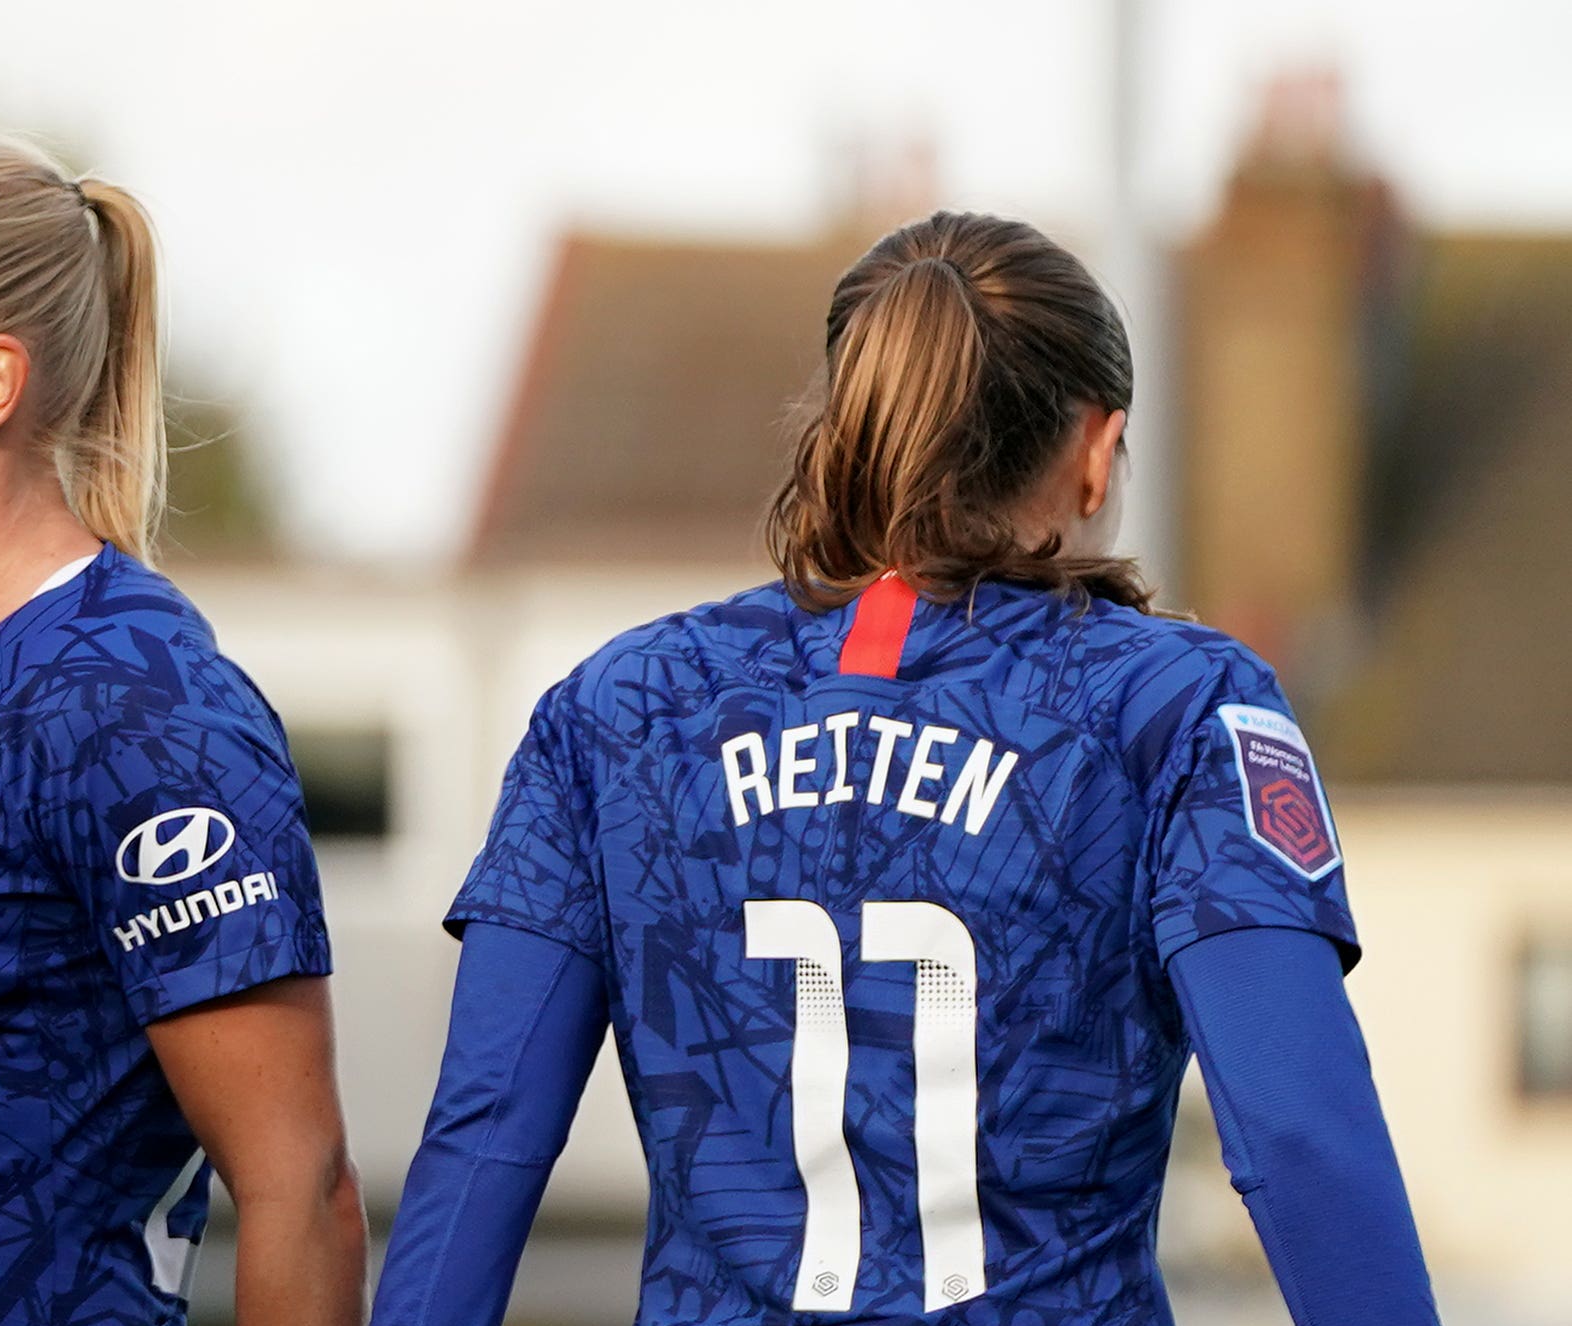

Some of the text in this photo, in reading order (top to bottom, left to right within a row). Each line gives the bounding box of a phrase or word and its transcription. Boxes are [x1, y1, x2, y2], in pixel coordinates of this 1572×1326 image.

[721, 711, 1019, 836] REITEN
[112, 871, 279, 953] HYUNDAI
[744, 900, 987, 1314] 11
